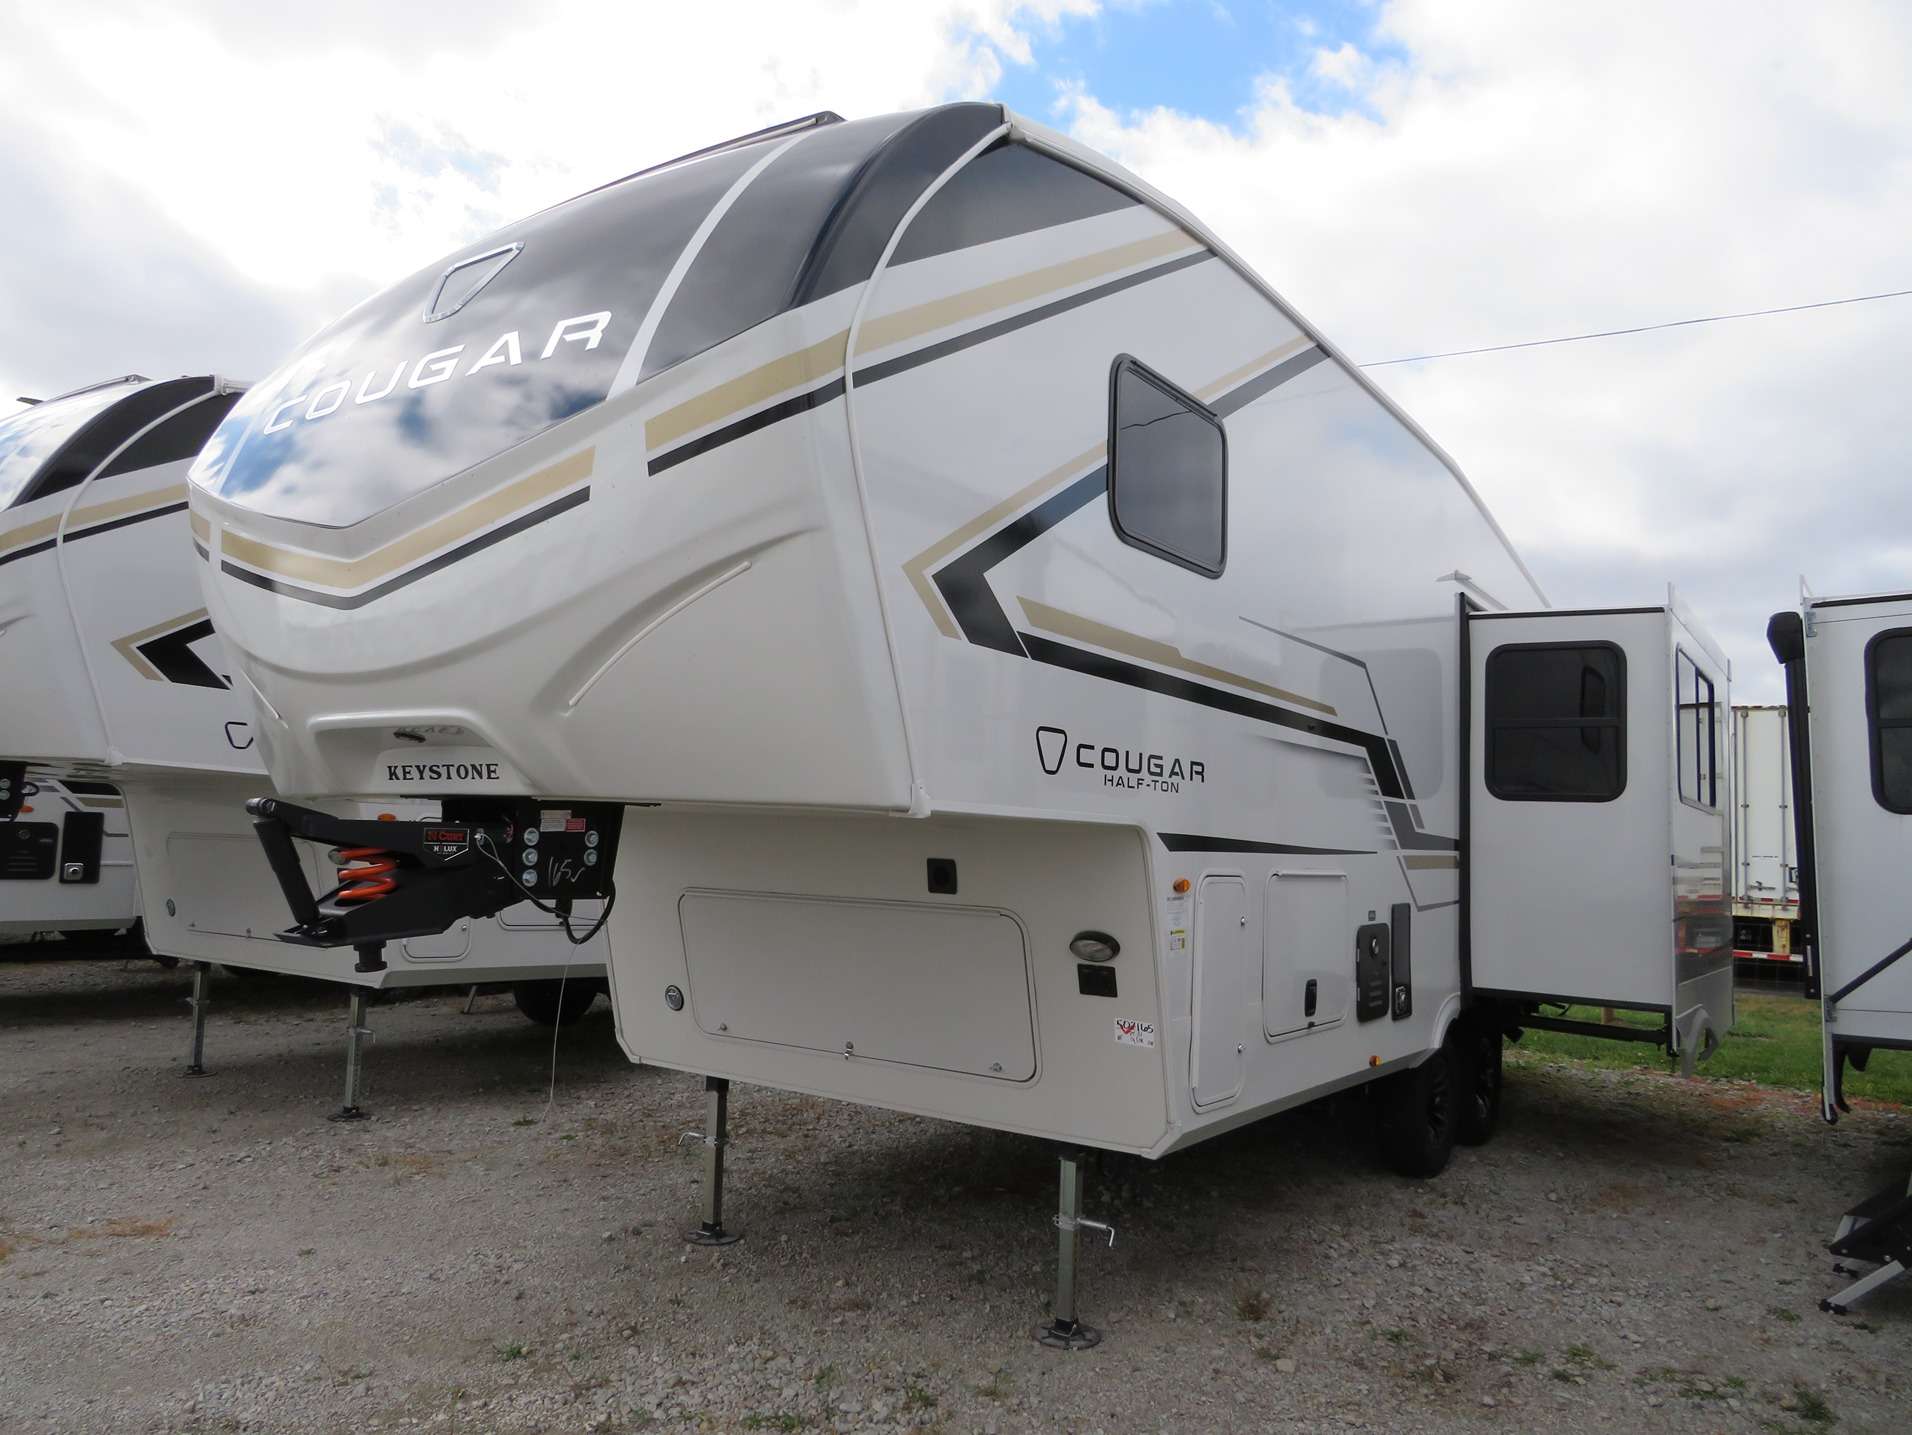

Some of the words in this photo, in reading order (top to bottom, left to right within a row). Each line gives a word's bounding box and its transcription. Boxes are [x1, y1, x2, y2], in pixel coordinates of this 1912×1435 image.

[263, 310, 612, 436] COUGAR
[387, 763, 500, 781] KEYSTONE
[1076, 743, 1206, 783] COUGAR
[1104, 774, 1180, 793] HALF-TON
